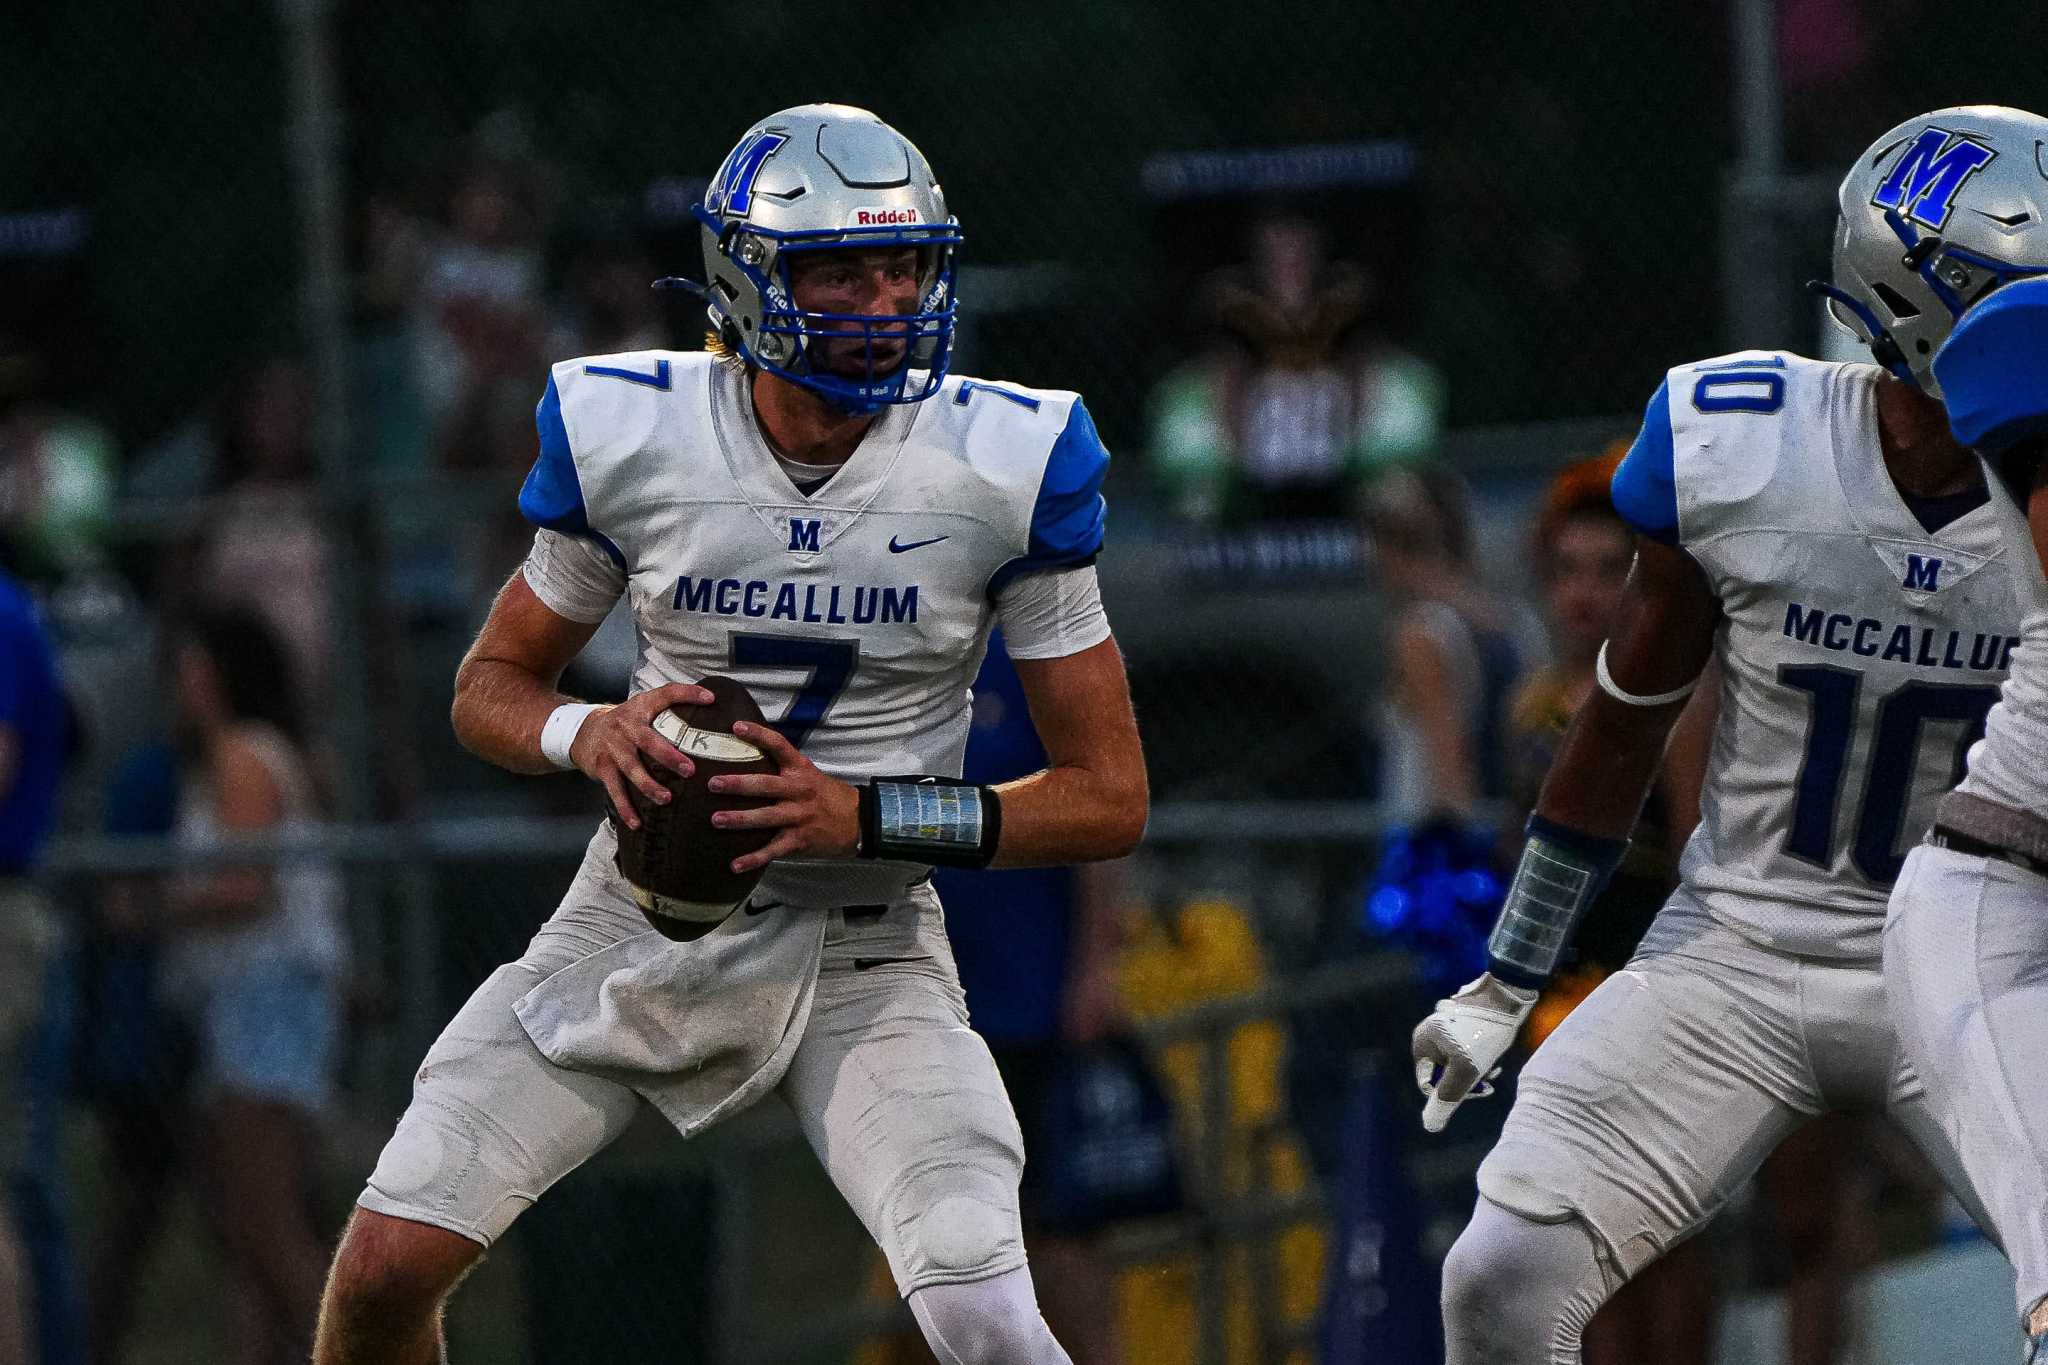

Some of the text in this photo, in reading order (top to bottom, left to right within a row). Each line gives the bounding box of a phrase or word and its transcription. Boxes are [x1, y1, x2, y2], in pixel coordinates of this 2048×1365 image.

[1870, 125, 1999, 233] M
[858, 209, 917, 225] Riddell
[584, 359, 672, 393] 7
[952, 380, 1042, 413] 7
[788, 517, 822, 553] M
[1901, 553, 1943, 593] M
[673, 575, 919, 624] MCCALLUM
[727, 630, 860, 748] 7
[1777, 662, 2004, 893] 10
